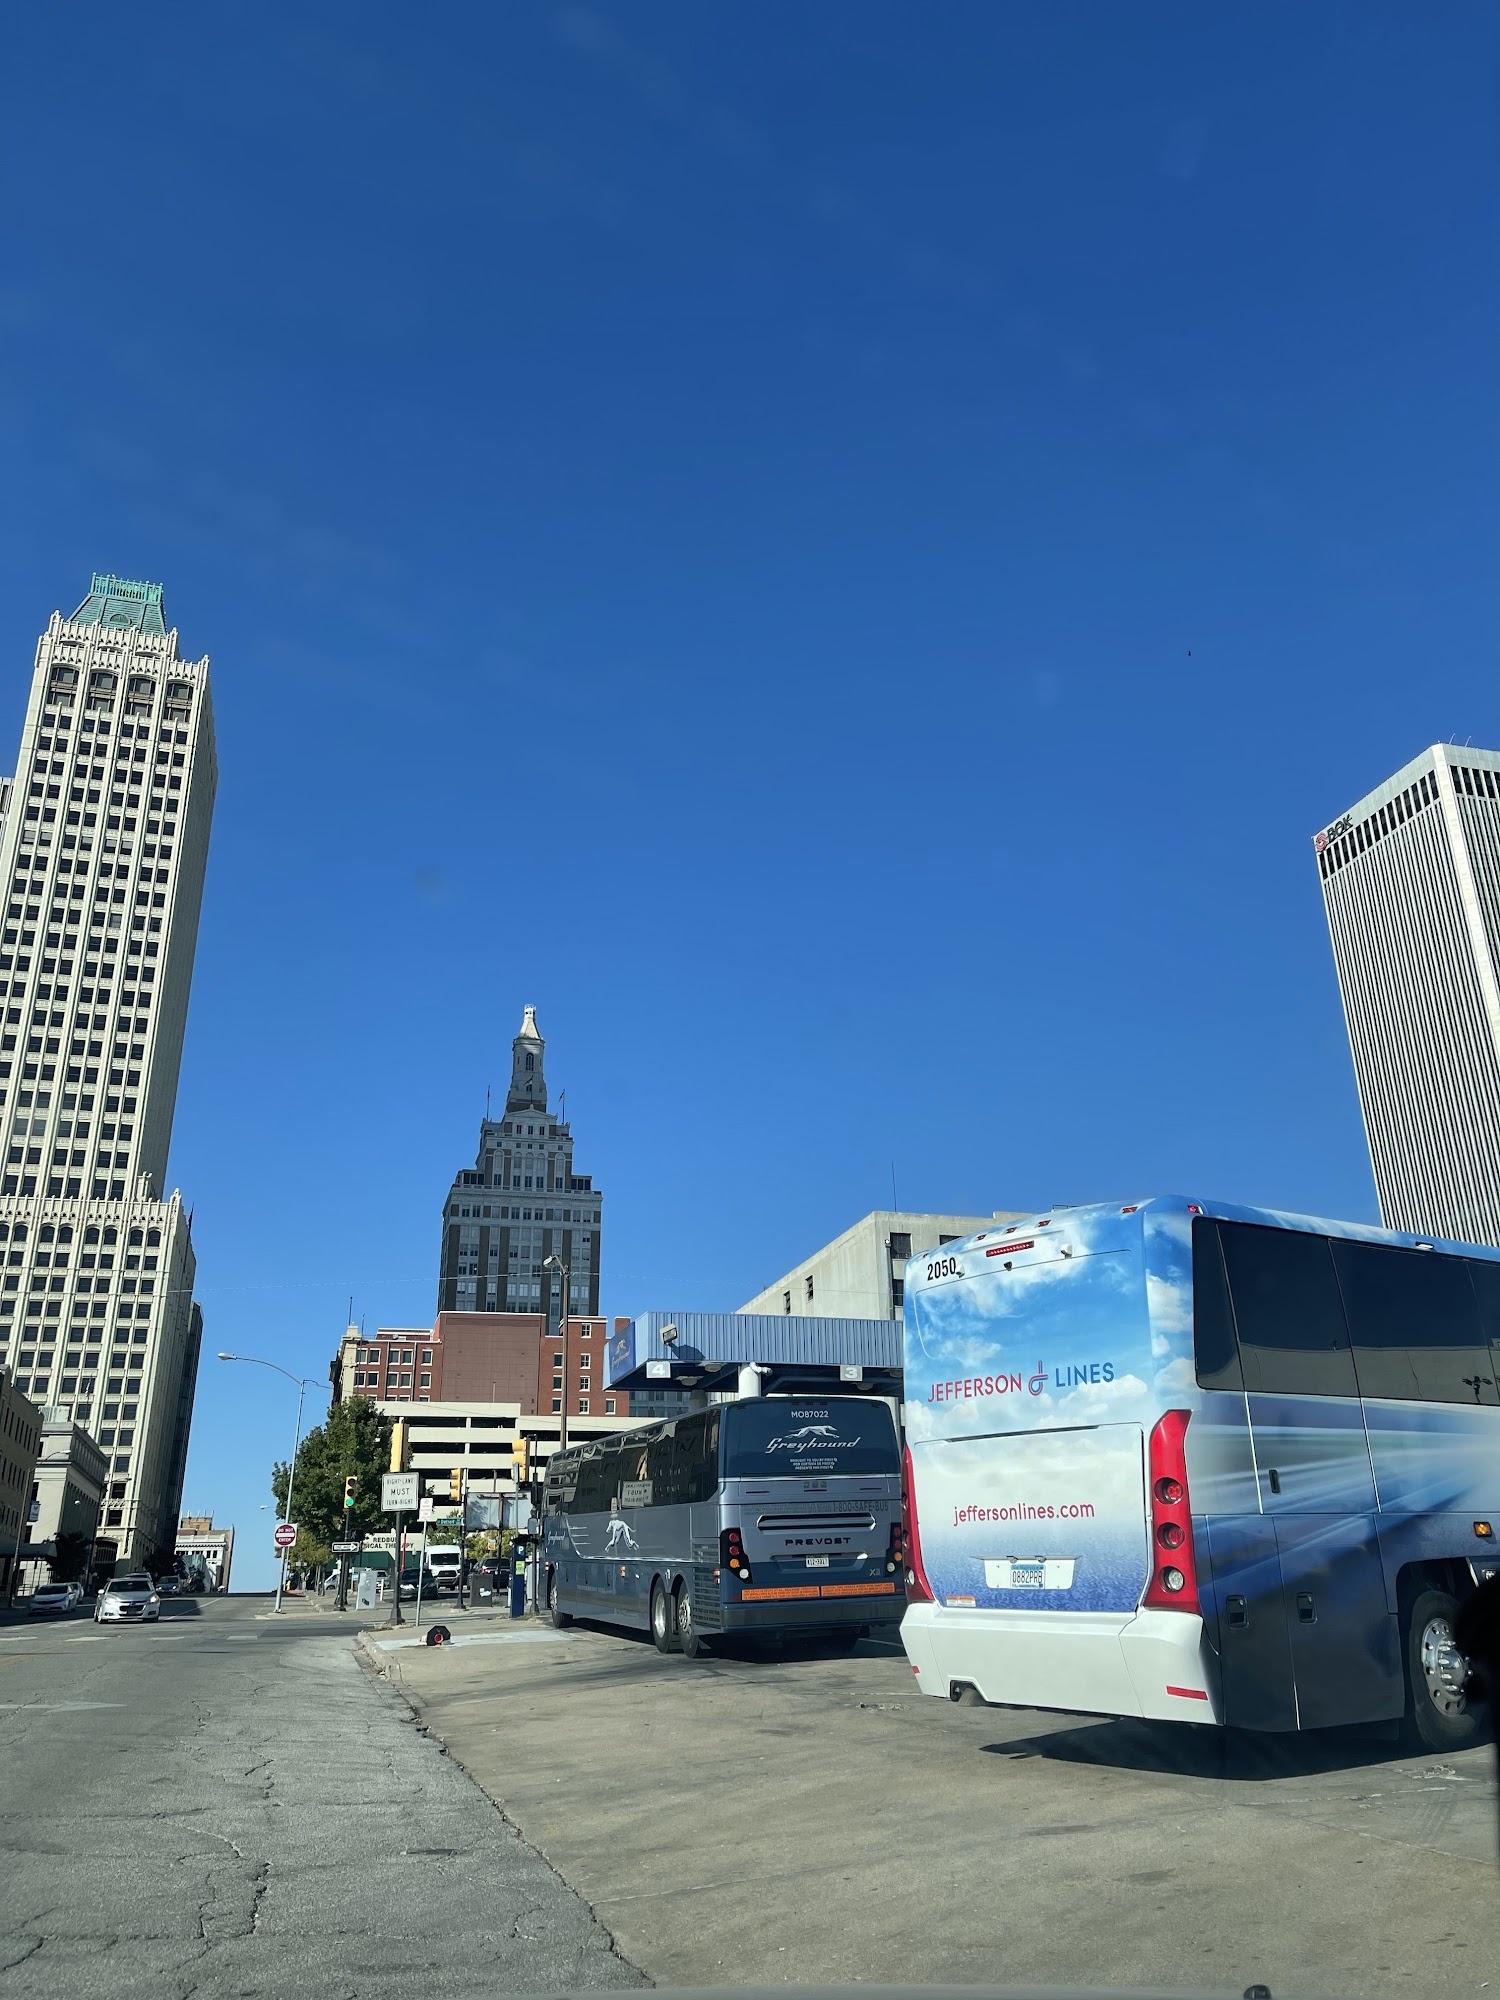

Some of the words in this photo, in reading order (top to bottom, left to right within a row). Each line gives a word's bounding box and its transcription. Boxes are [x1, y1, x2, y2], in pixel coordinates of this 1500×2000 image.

[1326, 813, 1354, 843] BOK
[927, 1256, 957, 1281] 2050
[651, 1363, 666, 1376] 4
[844, 1367, 858, 1379] 3
[927, 1372, 1022, 1403] JEFFERSON
[1055, 1362, 1115, 1388] LINES
[790, 1410, 829, 1419] MO87022
[764, 1436, 862, 1454] Greyhound
[390, 1487, 410, 1496] MUST
[832, 1501, 889, 1513] 1-800-SAFE-BUS
[953, 1502, 1095, 1527] jeffersonlines.com
[785, 1537, 852, 1546] PREVOST
[518, 1545, 525, 1555] P
